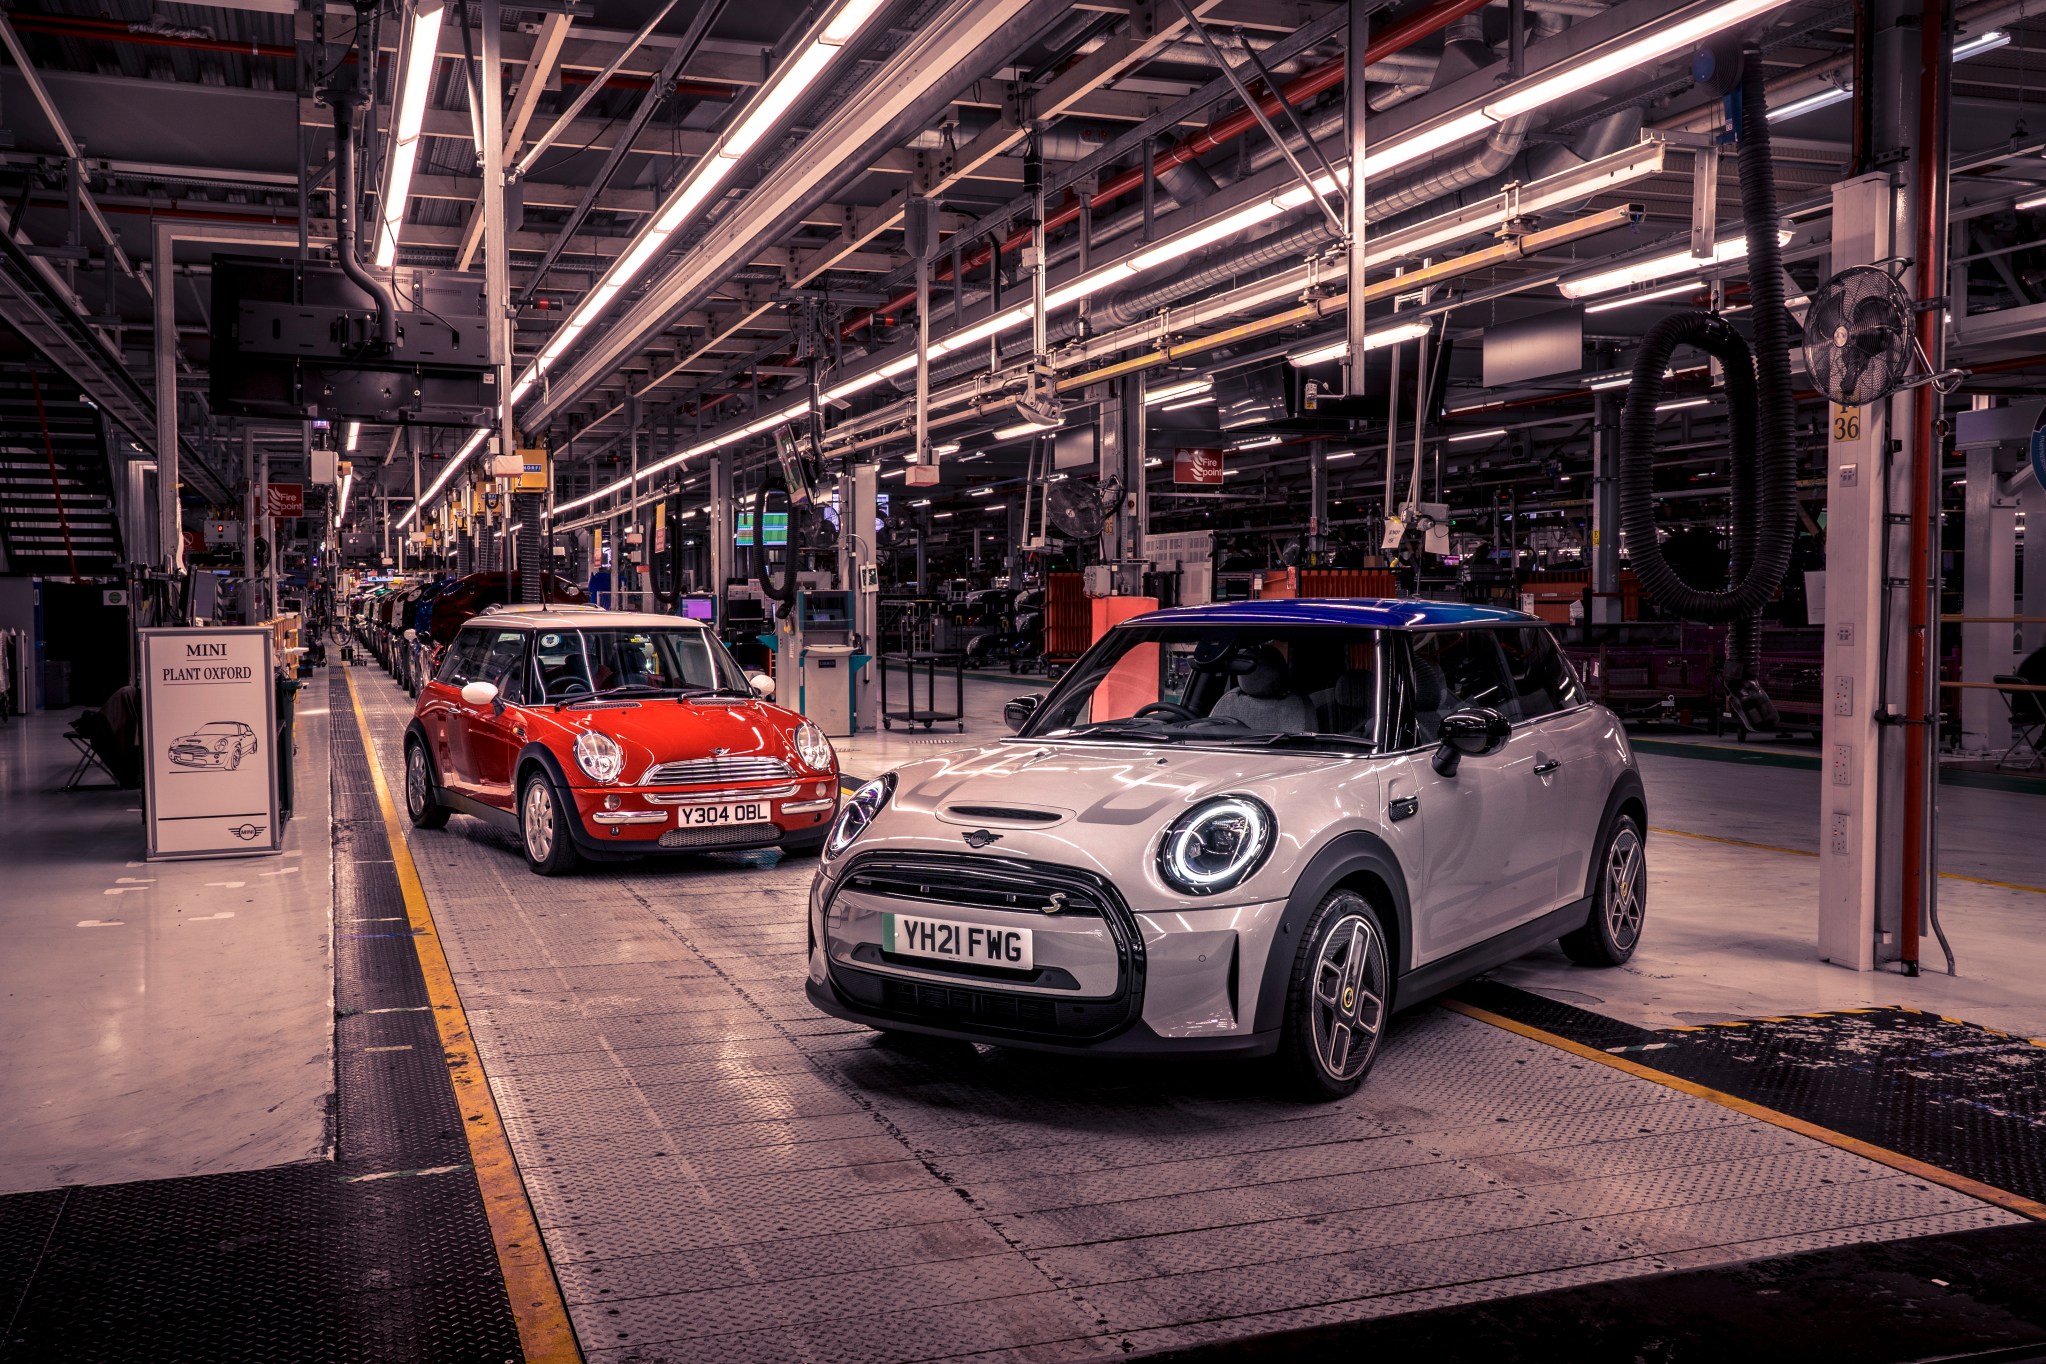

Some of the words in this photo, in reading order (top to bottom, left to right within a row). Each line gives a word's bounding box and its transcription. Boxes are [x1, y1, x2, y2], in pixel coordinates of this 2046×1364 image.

[1834, 415, 1859, 440] 36
[1202, 458, 1218, 467] Fire
[1202, 468, 1222, 477] point
[280, 493, 297, 501] Fire
[280, 503, 302, 511] point
[186, 643, 227, 657] MINI
[162, 667, 201, 681] PLANT
[203, 666, 252, 680] OXFORD
[682, 806, 729, 824] Y304
[904, 919, 960, 955] YH21
[968, 927, 1021, 962] FWG
